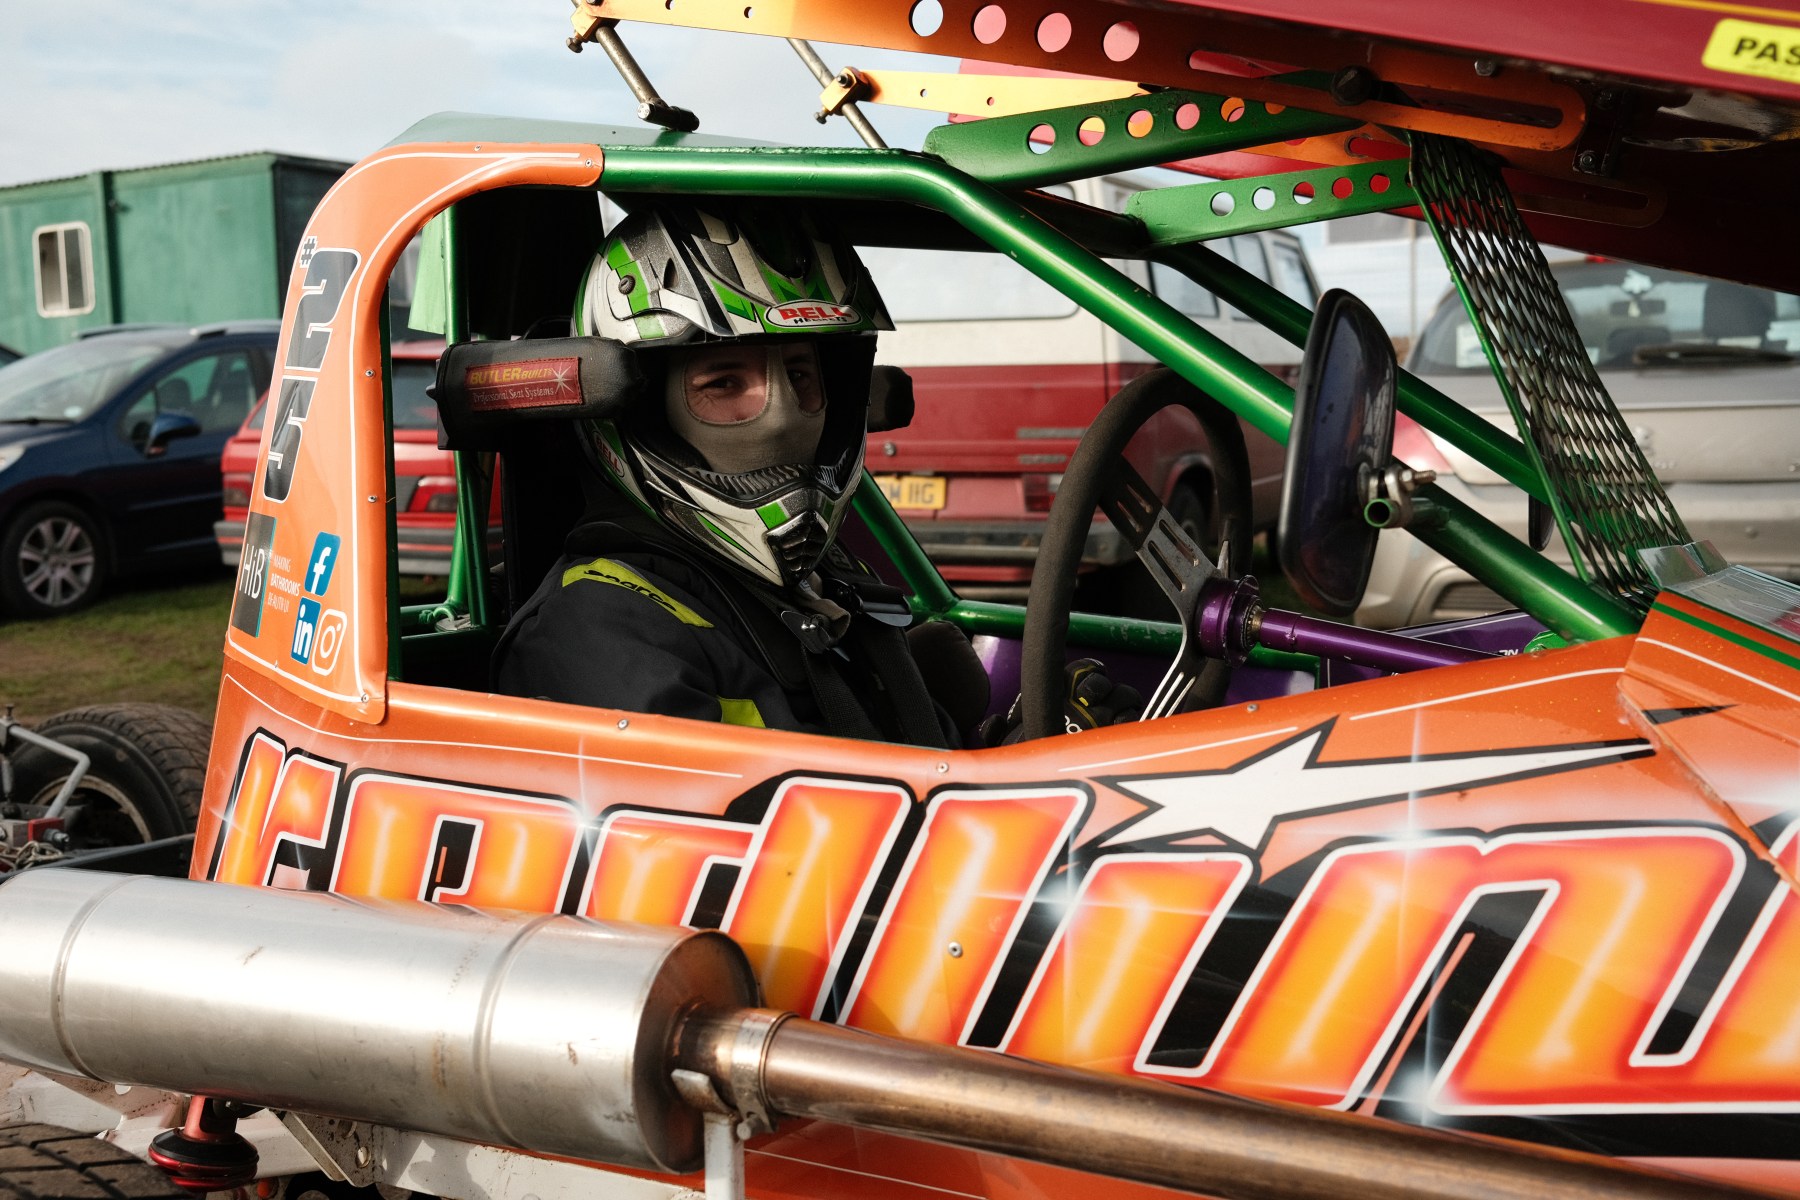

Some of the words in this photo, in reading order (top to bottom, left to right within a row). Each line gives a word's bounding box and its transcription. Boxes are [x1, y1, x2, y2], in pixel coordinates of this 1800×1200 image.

[778, 307, 852, 320] BELL
[509, 388, 524, 398] Seat
[525, 386, 554, 399] Systems
[239, 543, 266, 599] HiB
[273, 555, 291, 573] MAKING
[270, 573, 301, 597] BATHROOMS
[294, 604, 313, 658] in
[205, 727, 1800, 1118] redlin
